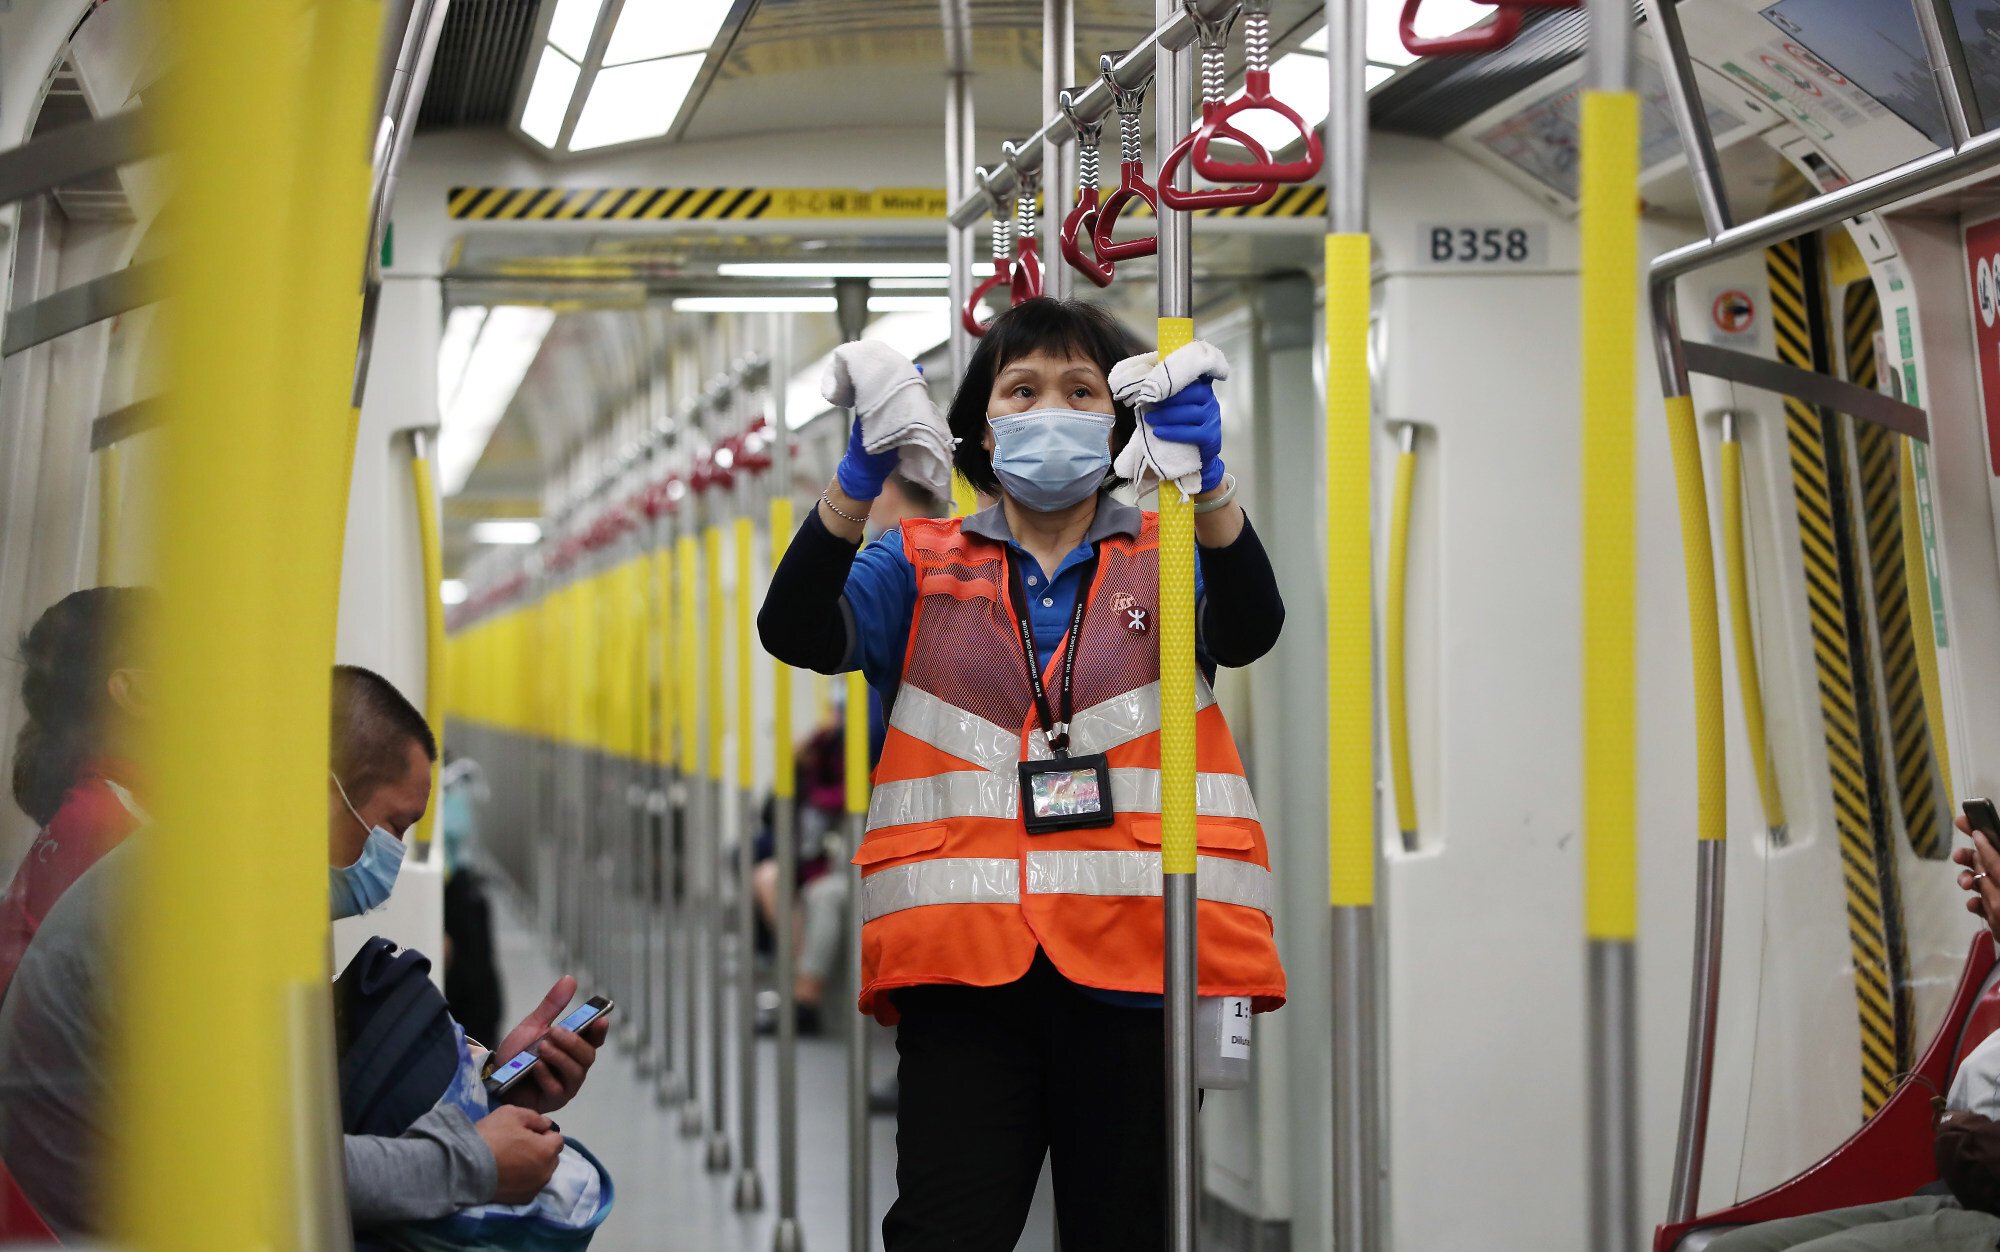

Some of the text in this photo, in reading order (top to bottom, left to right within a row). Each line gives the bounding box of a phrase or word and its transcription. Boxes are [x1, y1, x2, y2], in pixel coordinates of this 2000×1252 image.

[881, 195, 924, 210] Mind
[1431, 227, 1528, 262] B358
[1021, 619, 1030, 638] CULTURE
[1066, 635, 1076, 662] EXCELLENCE
[1074, 603, 1083, 623] GROWTH
